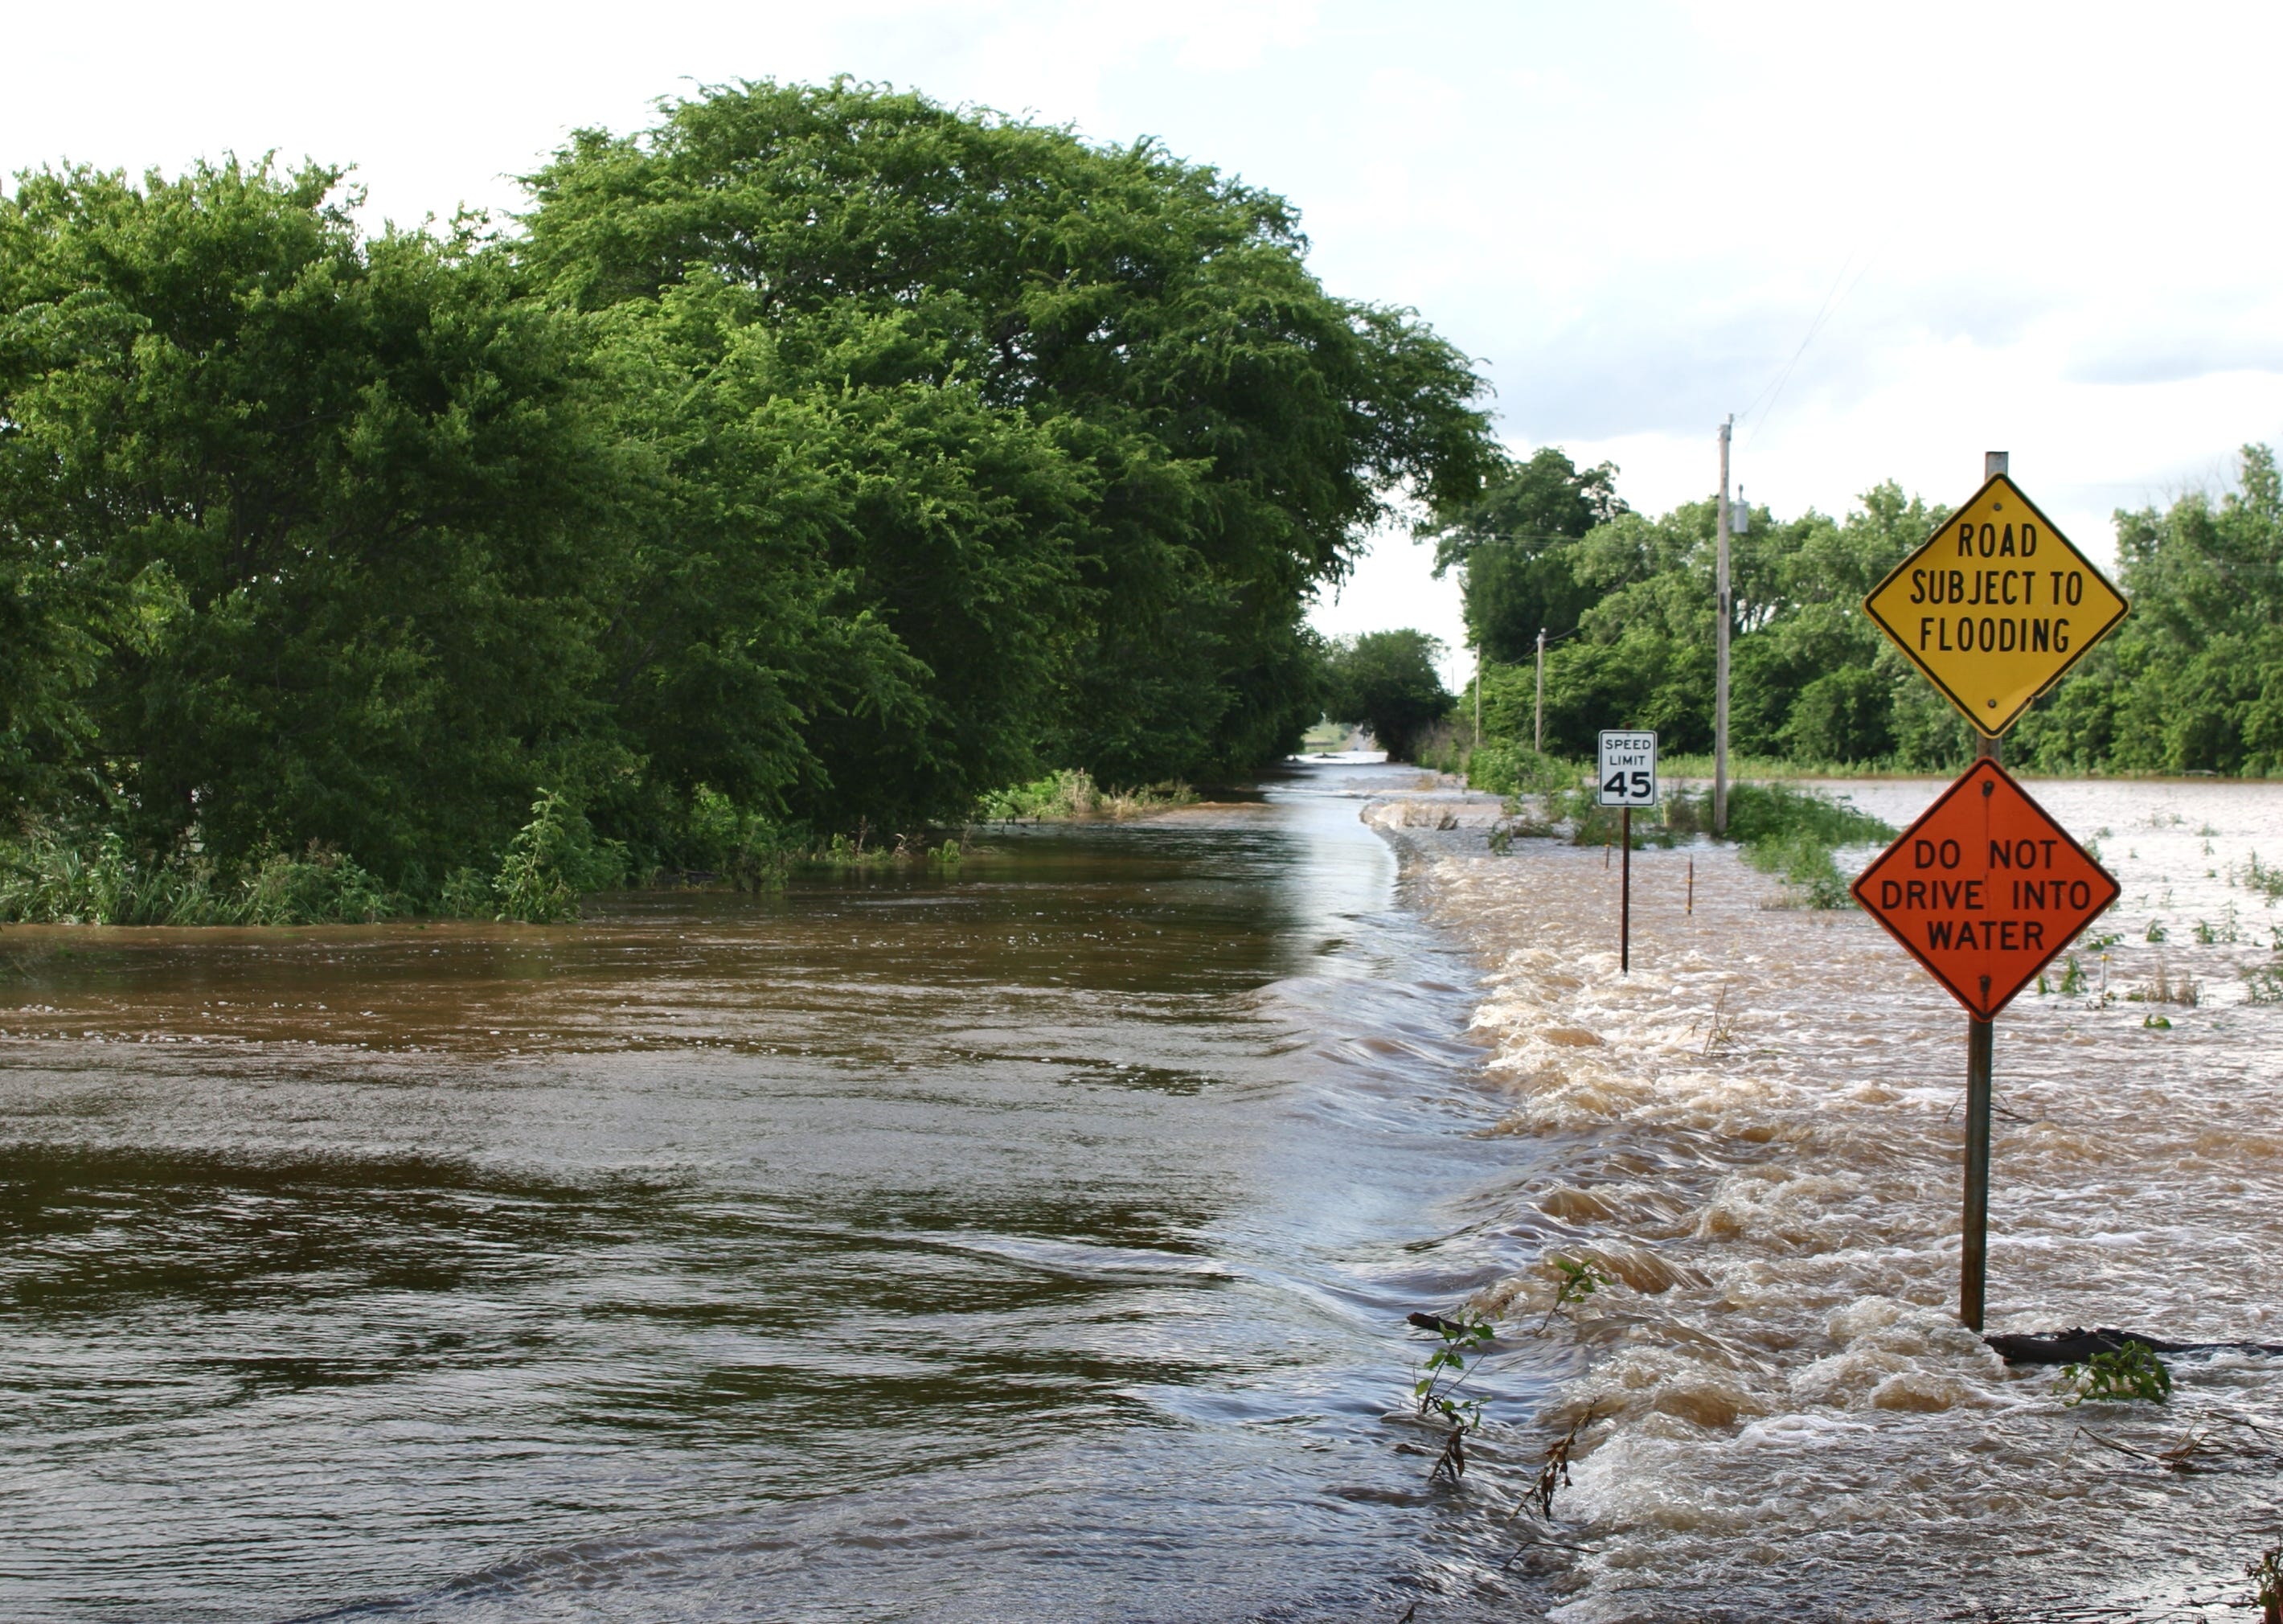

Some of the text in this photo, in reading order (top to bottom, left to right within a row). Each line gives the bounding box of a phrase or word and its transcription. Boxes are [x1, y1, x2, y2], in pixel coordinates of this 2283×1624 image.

[1957, 523, 2037, 558] ROAD
[1910, 569, 2083, 606] SUBJECT TO
[1920, 617, 2070, 653] FLOODING
[1605, 739, 1651, 750] SPEED
[1609, 755, 1646, 765] LIMIT
[1603, 771, 1651, 798] 45
[1915, 839, 2058, 870] DO NOT
[1881, 880, 2091, 911] DRIVE INTO
[1927, 921, 2044, 950] WATER
